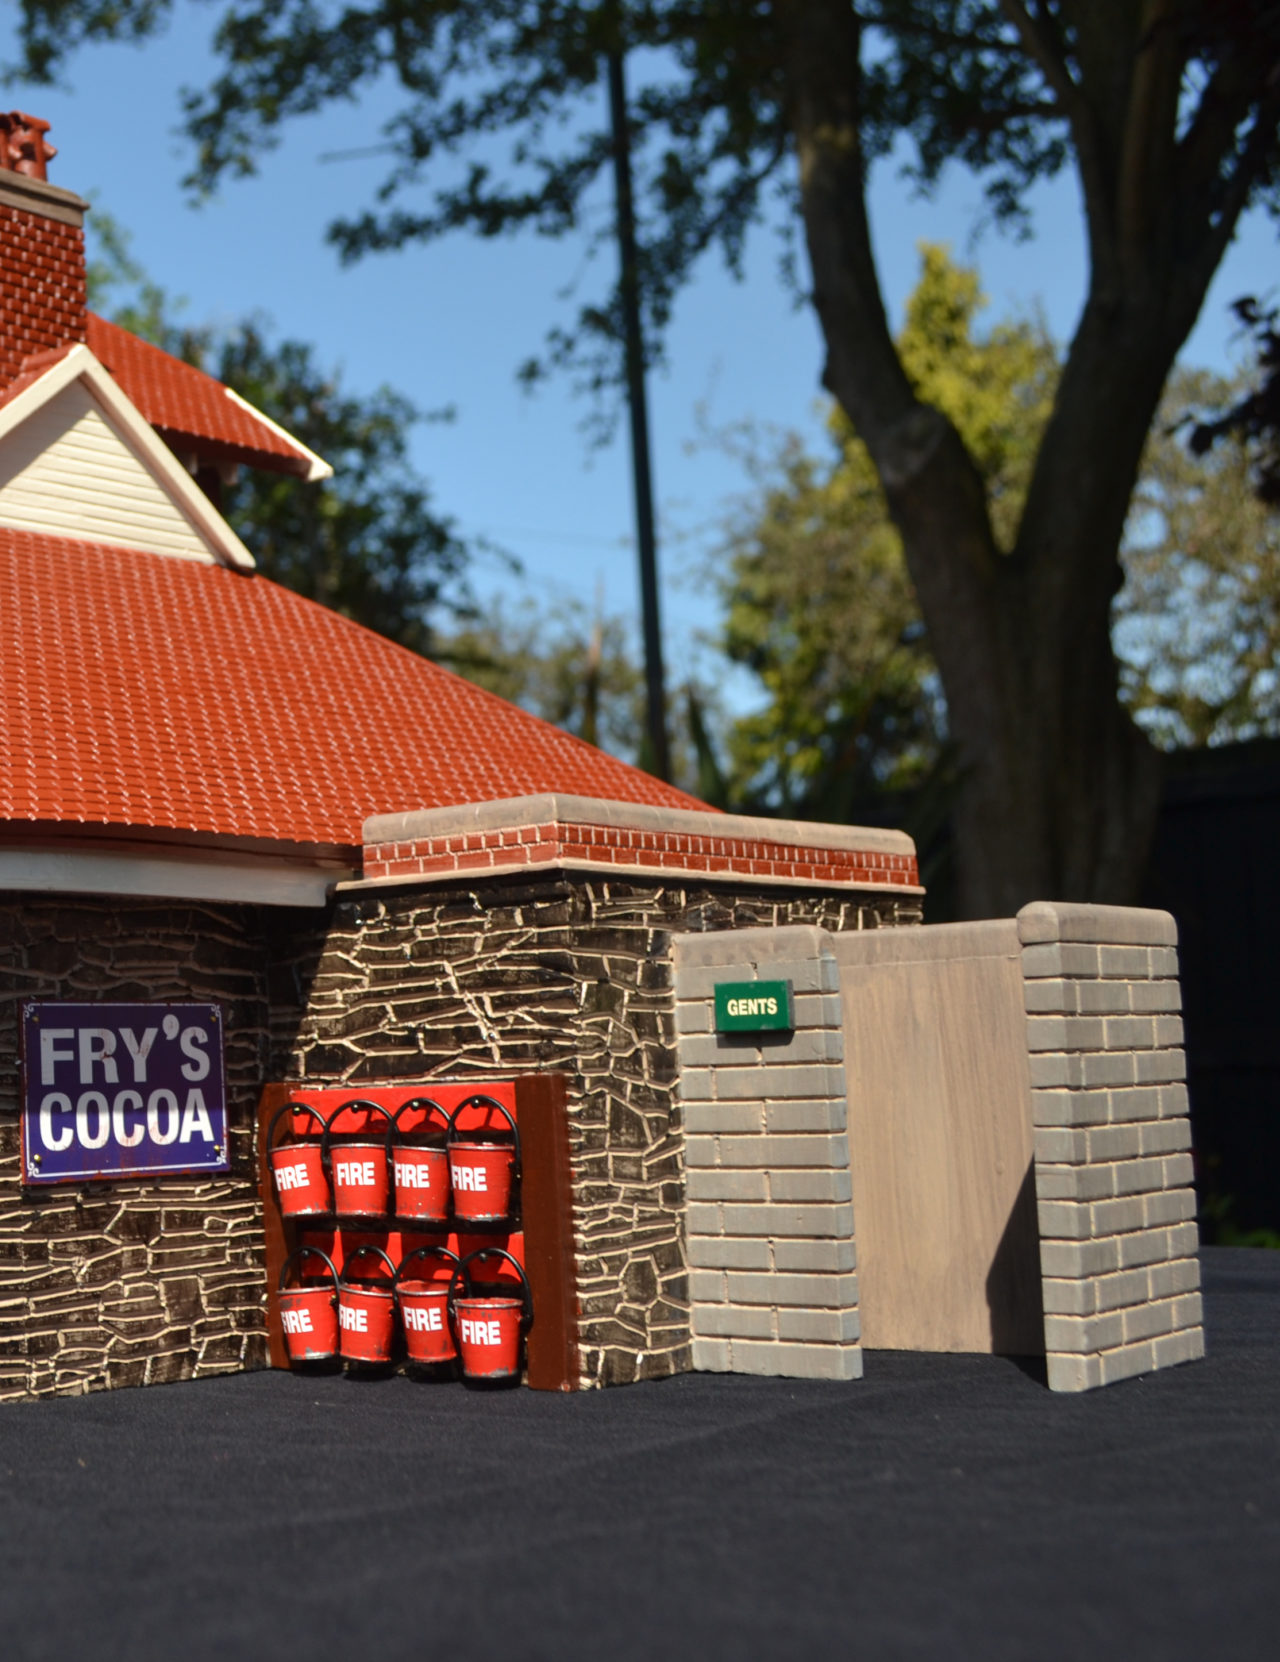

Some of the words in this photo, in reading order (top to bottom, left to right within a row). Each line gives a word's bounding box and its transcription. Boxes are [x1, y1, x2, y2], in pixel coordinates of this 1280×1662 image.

[727, 997, 778, 1016] GENTS
[39, 1087, 215, 1152] COCOA
[274, 1163, 310, 1192] FIRE
[336, 1162, 375, 1186] FIRE
[394, 1163, 430, 1188] FIRE
[451, 1165, 487, 1191] FIRE
[403, 1306, 443, 1331] FIRE
[461, 1319, 501, 1345] FIRE
